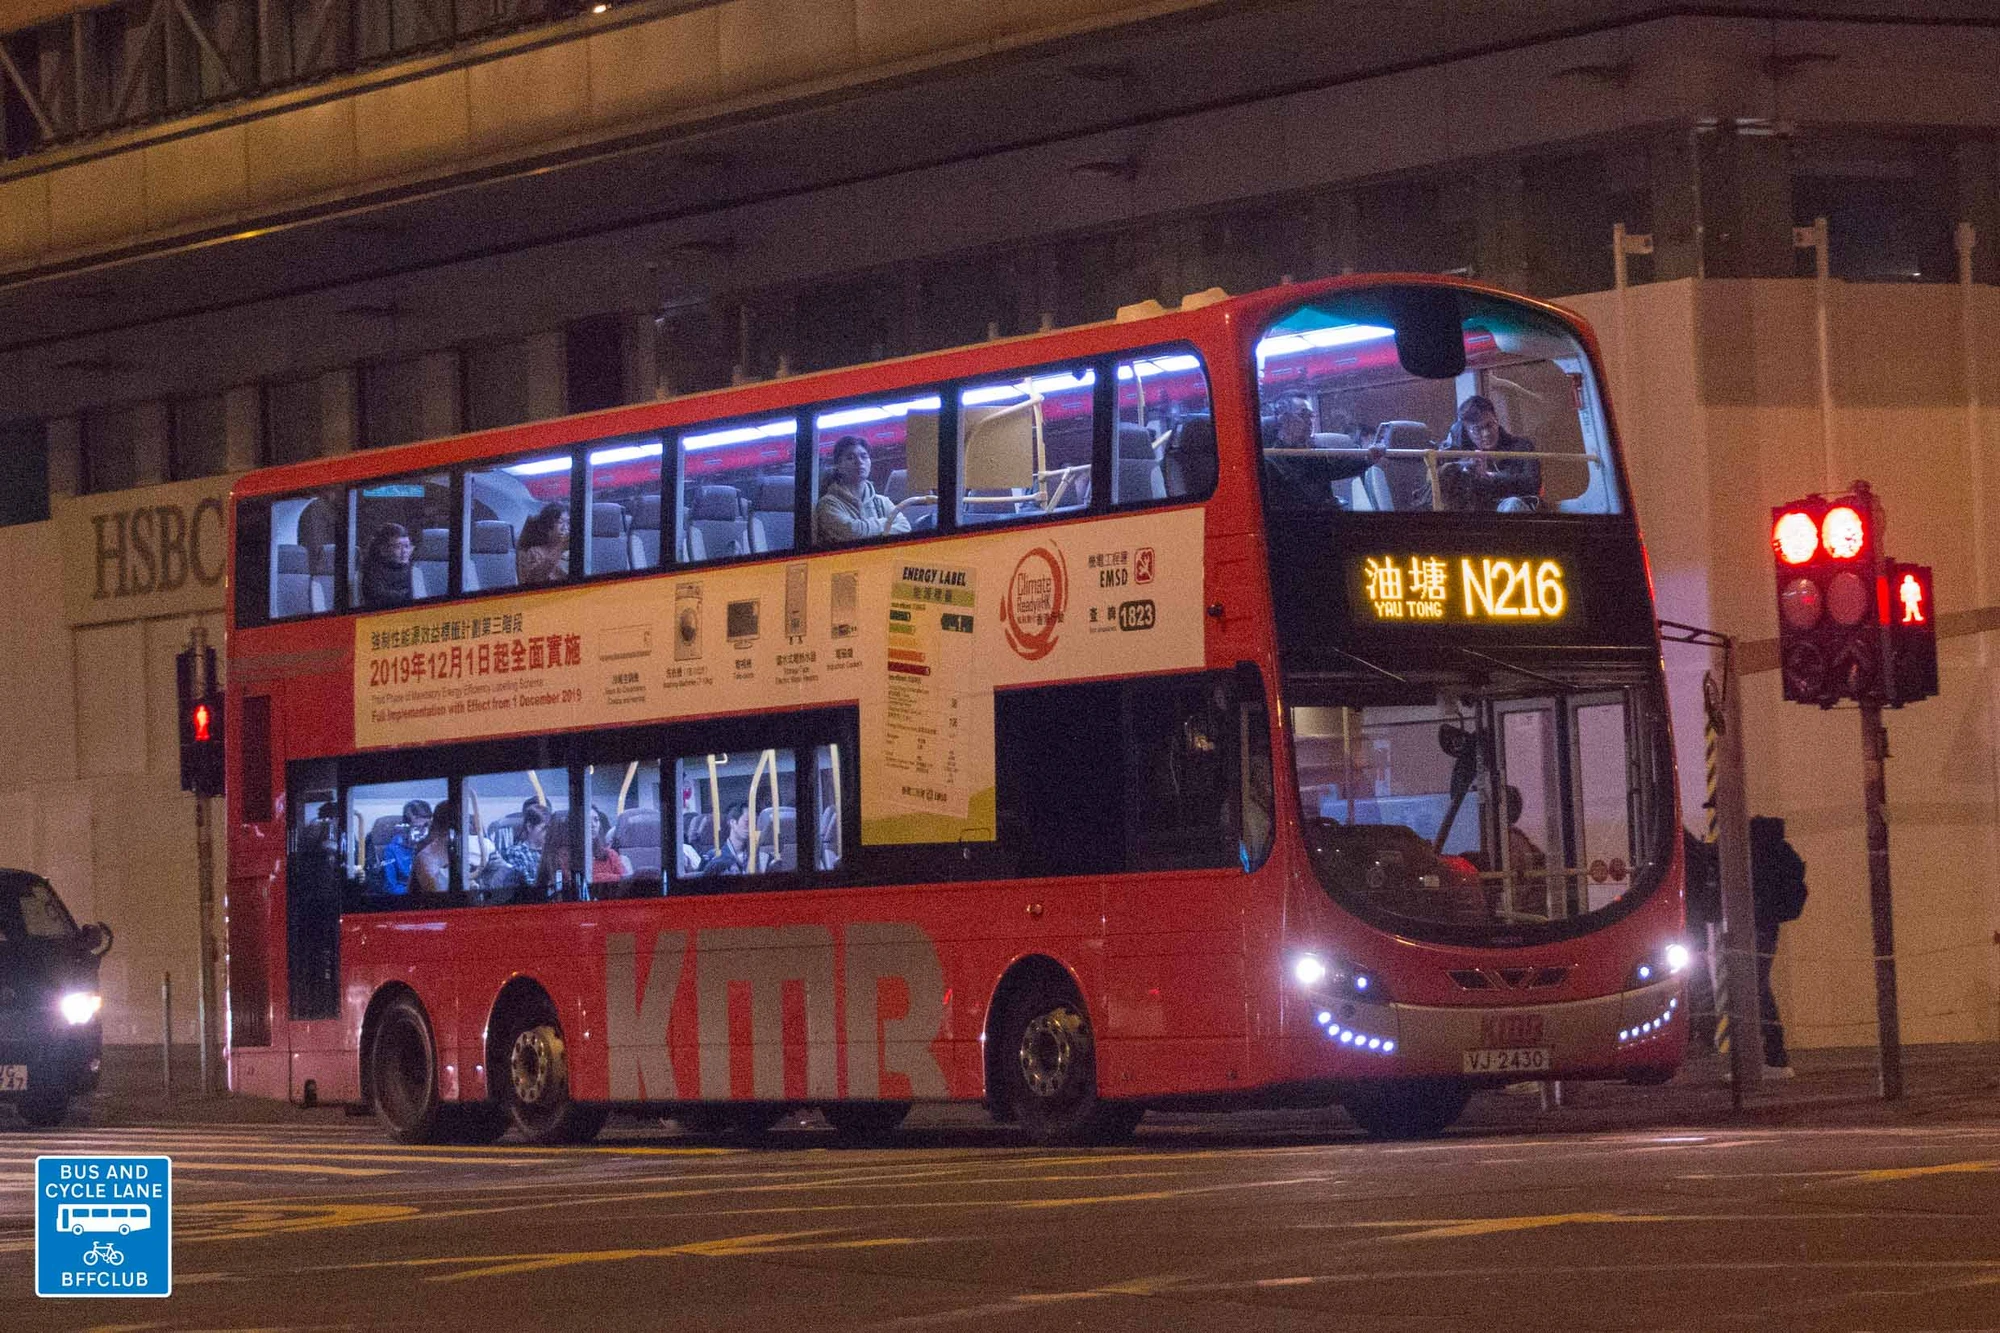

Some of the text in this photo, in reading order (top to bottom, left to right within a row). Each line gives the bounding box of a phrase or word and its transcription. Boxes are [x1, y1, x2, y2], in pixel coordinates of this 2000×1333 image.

[91, 498, 226, 600] HSBC
[902, 566, 967, 587] ENERGY LABEL
[1017, 573, 1052, 596] Climate
[1100, 569, 1128, 588] EMSD
[1364, 556, 1447, 600] 油塘
[1461, 558, 1565, 617] N216
[1121, 604, 1153, 628] 1823
[1375, 602, 1443, 618] YAU TONG
[519, 691, 560, 708] December
[561, 687, 582, 703] 2019
[1467, 1051, 1543, 1070] VJ 2430
